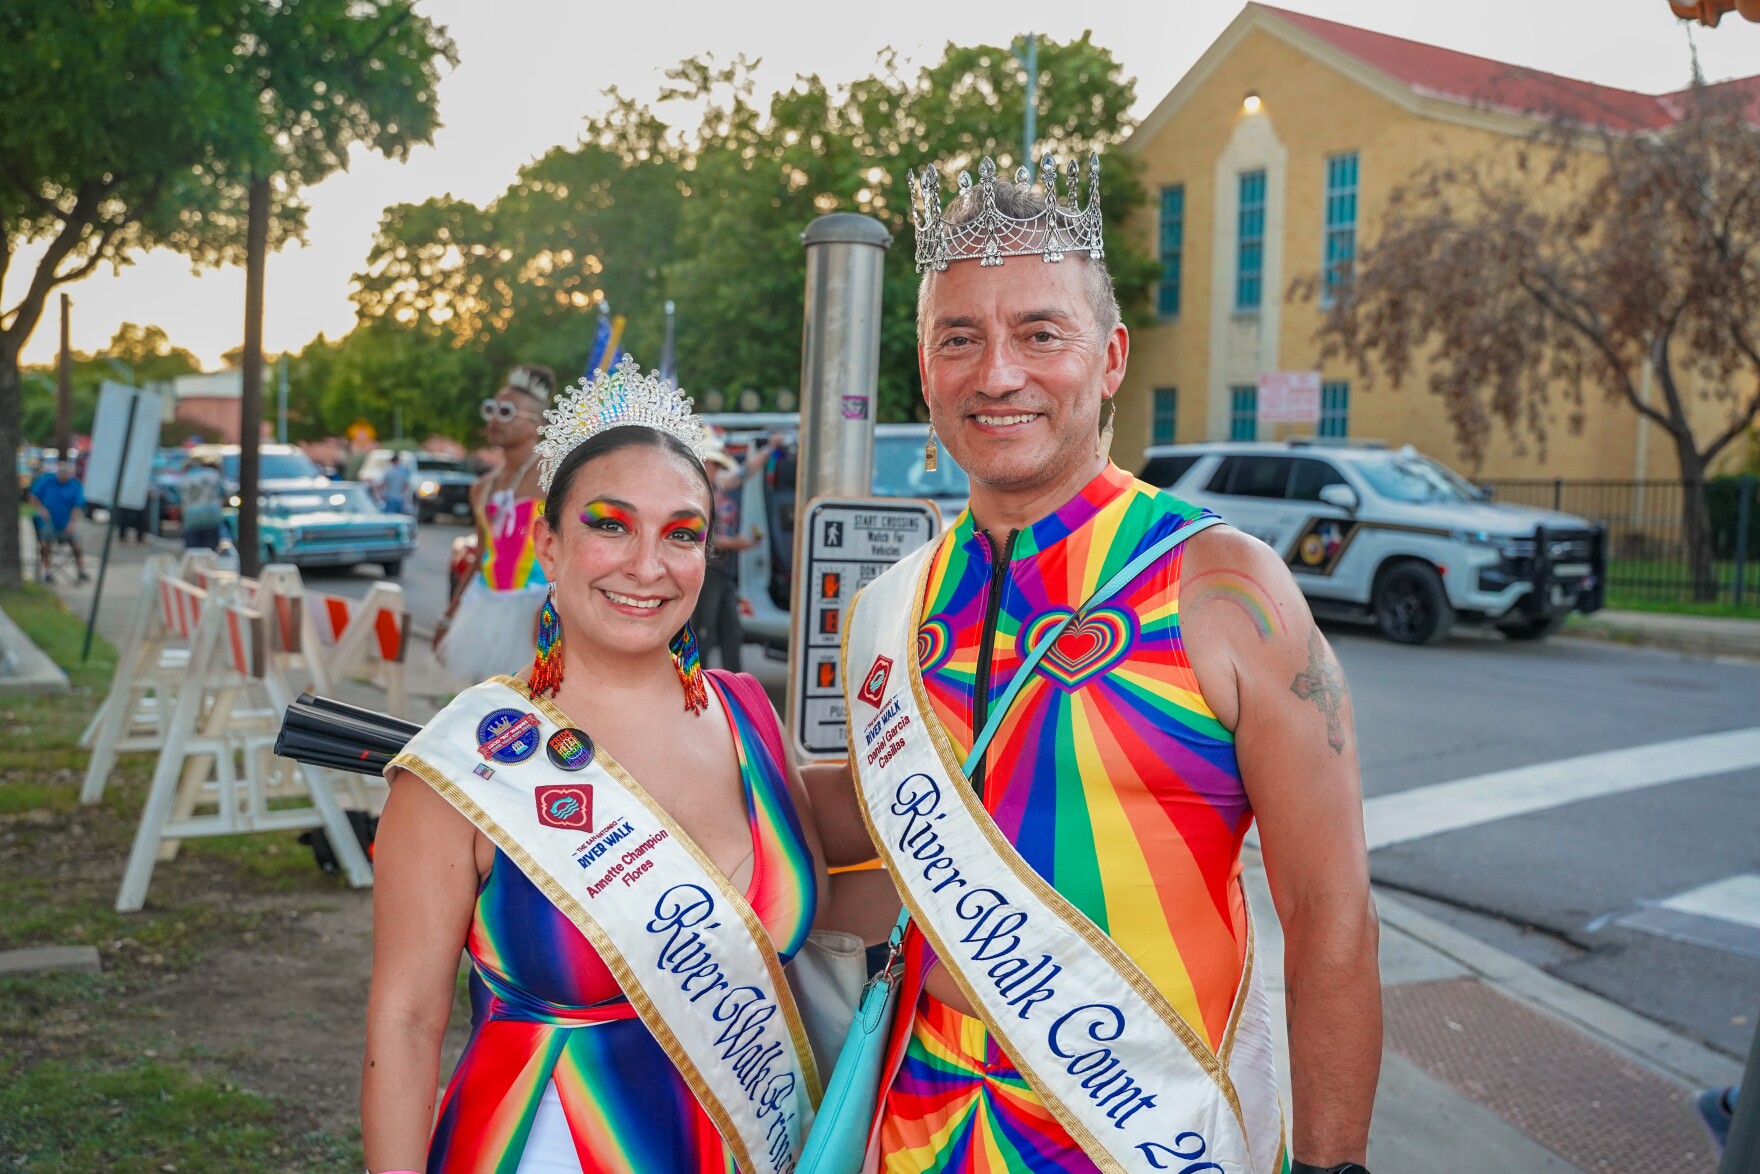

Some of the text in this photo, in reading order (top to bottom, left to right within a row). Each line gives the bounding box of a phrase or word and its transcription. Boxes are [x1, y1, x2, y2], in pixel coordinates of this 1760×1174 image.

[854, 514, 919, 528] START CROSSING
[868, 530, 905, 543] Watch For
[872, 545, 900, 555] Vehicles
[549, 729, 571, 746] PRIDE
[866, 700, 901, 746] RIVER WALK
[562, 741, 584, 759] PRIDE
[867, 716, 911, 766] Daniel Garcia
[879, 738, 906, 768] Casillas
[570, 750, 592, 768] PRIDE
[576, 820, 618, 853] THE SAN ANTONIO
[577, 821, 635, 869] RIVER WALK
[586, 829, 669, 899] Annette Champion
[621, 859, 654, 887] Flores
[891, 773, 967, 894] River
[955, 888, 1063, 1020] Walk
[1047, 1003, 1158, 1130] Count
[646, 884, 729, 1003] River
[712, 986, 784, 1101] Walk
